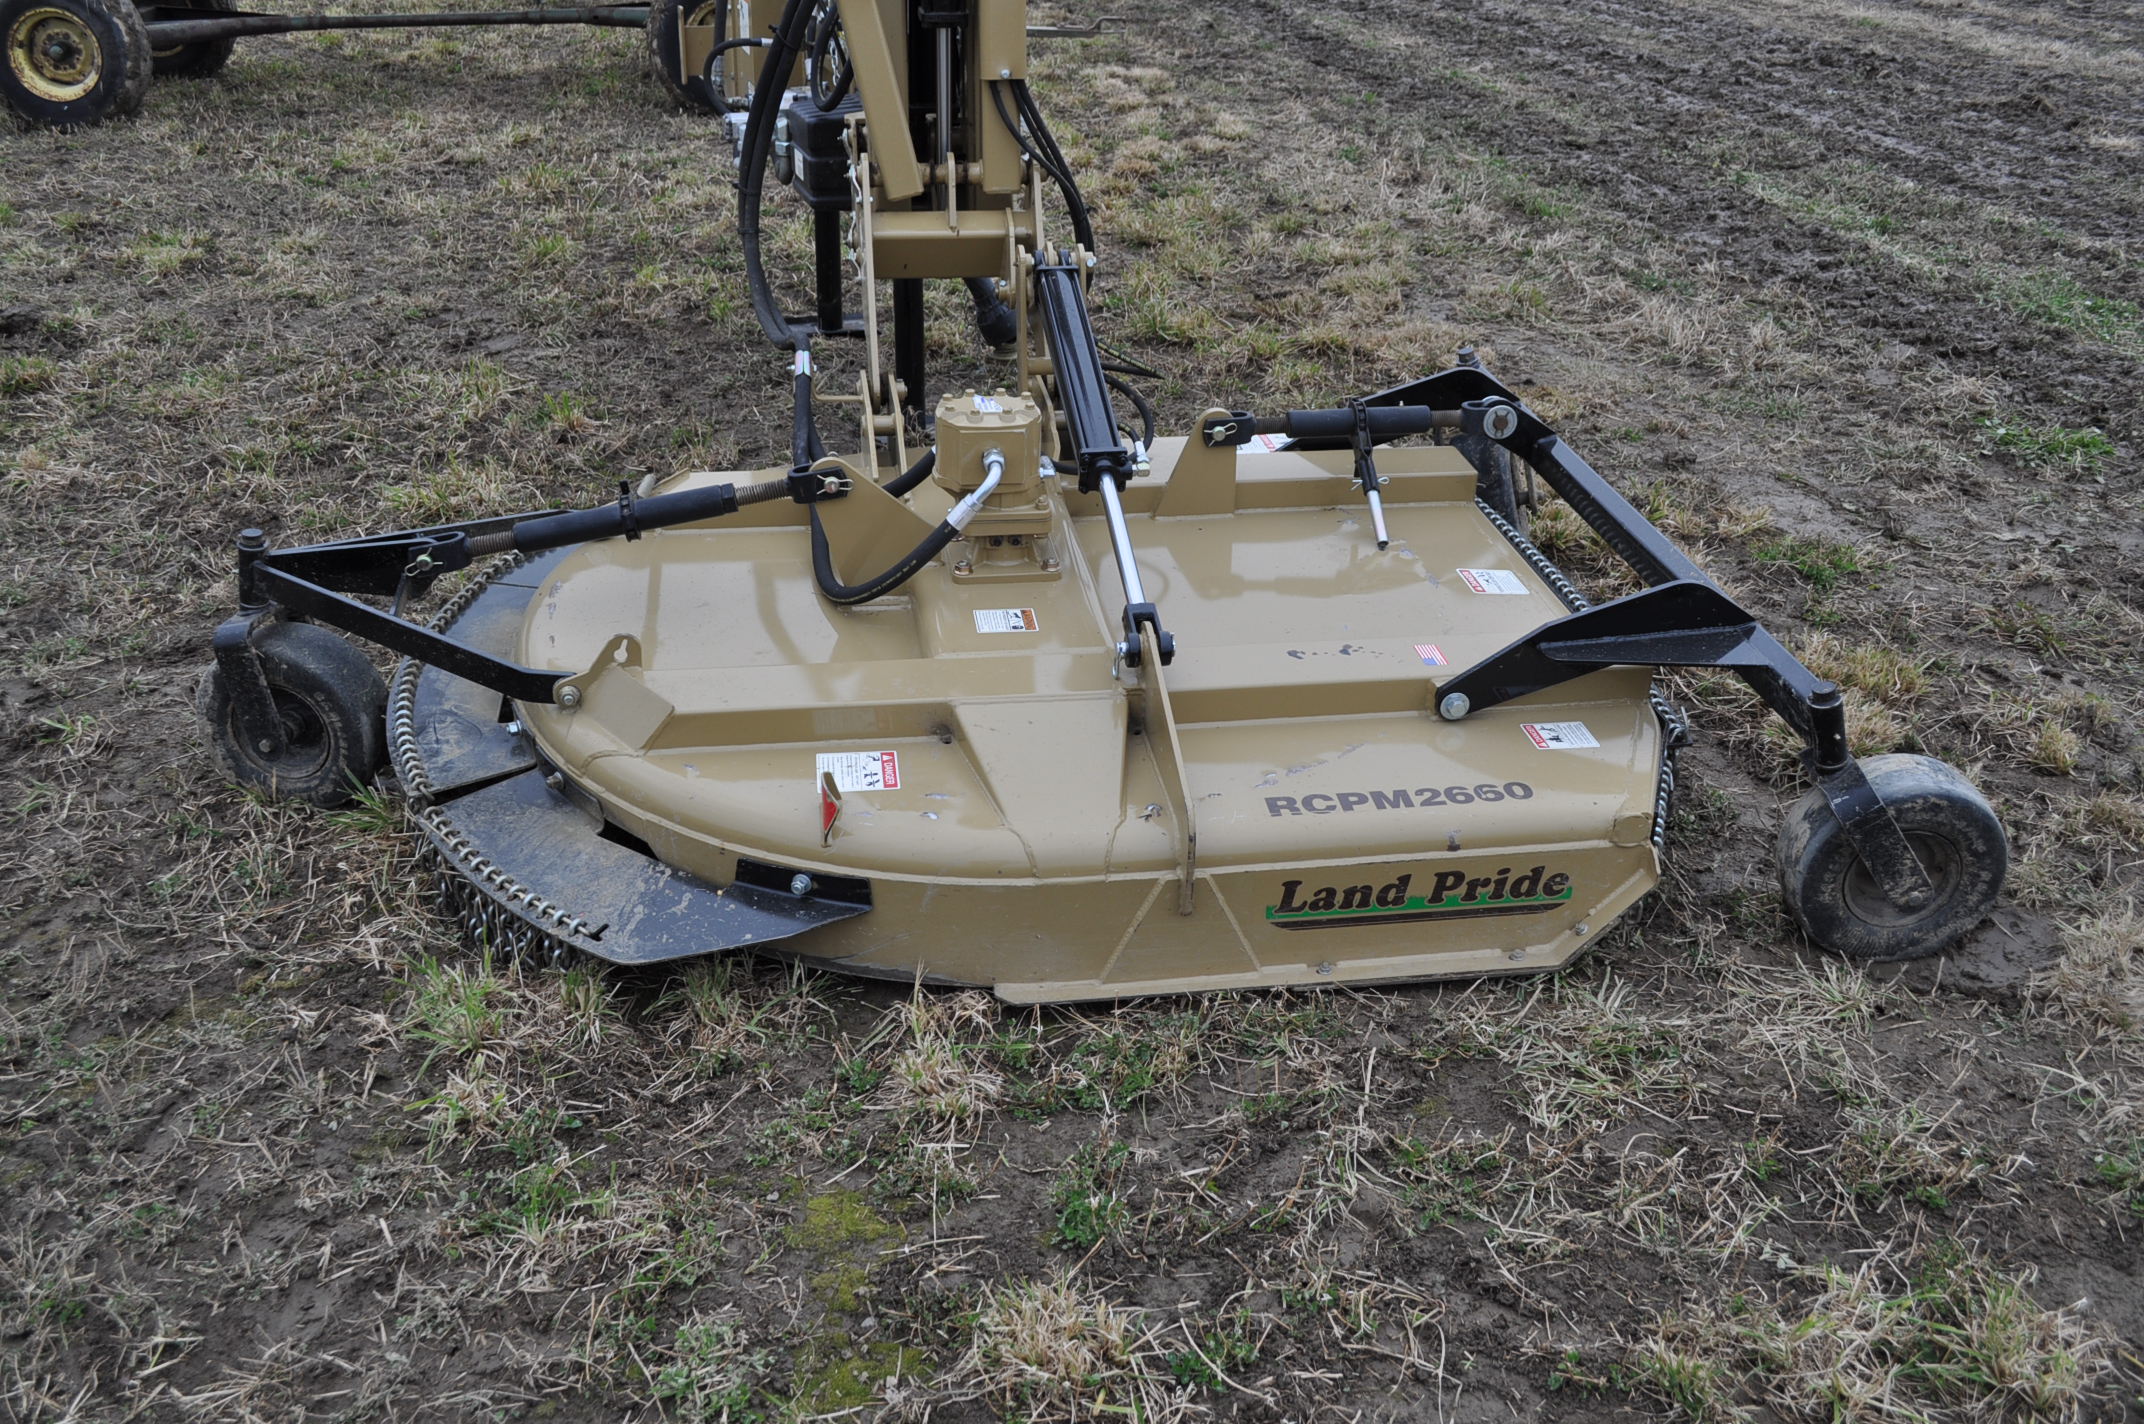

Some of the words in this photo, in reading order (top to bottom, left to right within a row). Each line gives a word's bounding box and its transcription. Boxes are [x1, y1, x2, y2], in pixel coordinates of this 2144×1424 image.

[1264, 782, 1534, 817] RCPM2660
[1273, 873, 1412, 914] Land
[1427, 865, 1570, 904] Pride
